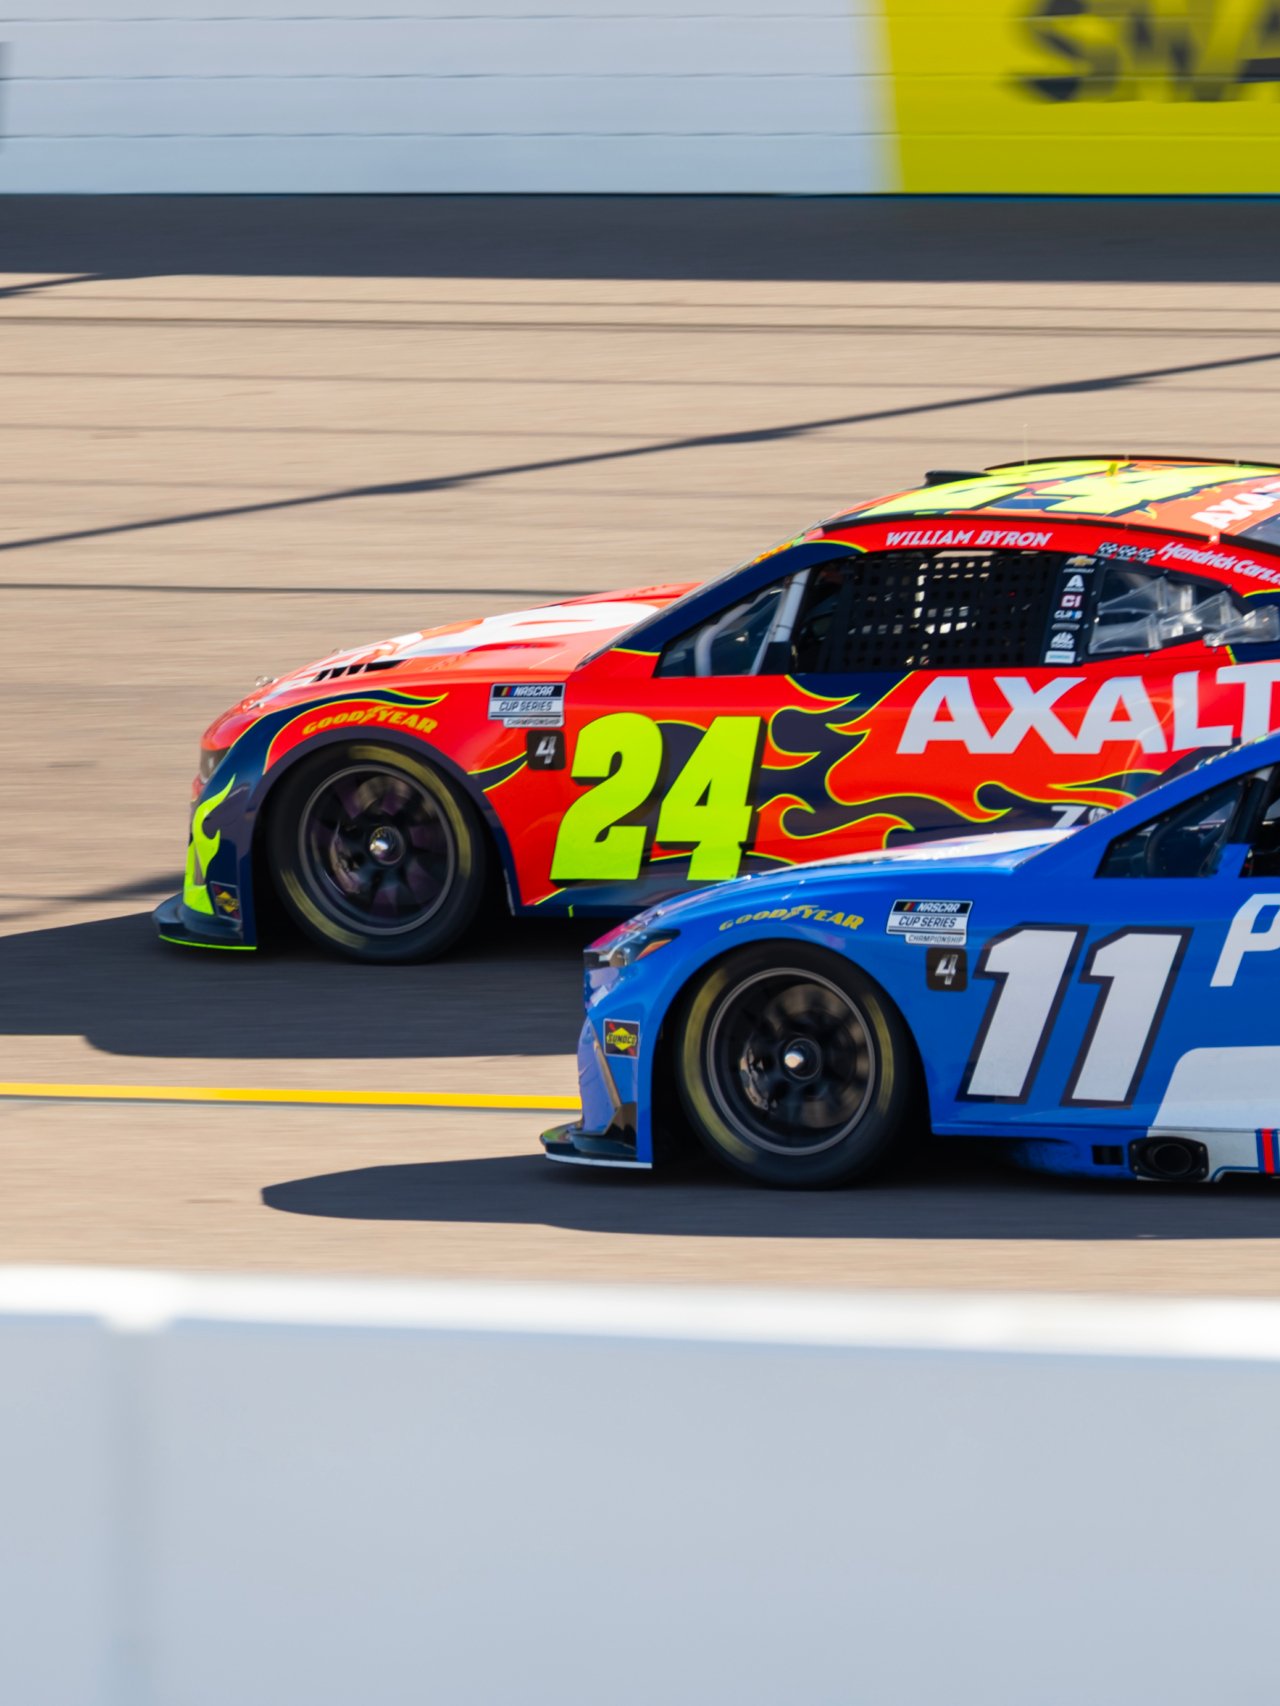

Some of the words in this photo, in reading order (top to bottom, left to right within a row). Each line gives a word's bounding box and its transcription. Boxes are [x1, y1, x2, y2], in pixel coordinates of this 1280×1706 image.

[885, 530, 973, 547] WILLIAM
[974, 530, 1053, 547] BYRON
[513, 686, 554, 697] NASCAR
[302, 705, 438, 735] GOODYEAR
[499, 701, 520, 712] CUP
[520, 701, 553, 711] SERIES
[535, 736, 556, 764] 4
[552, 711, 761, 882] 24
[719, 904, 864, 931] GOODYEAR
[917, 902, 960, 913] NASCAR
[898, 915, 920, 926] CUP
[920, 916, 957, 928] SERIES
[934, 954, 959, 986] 4
[954, 923, 1194, 1108] 11
